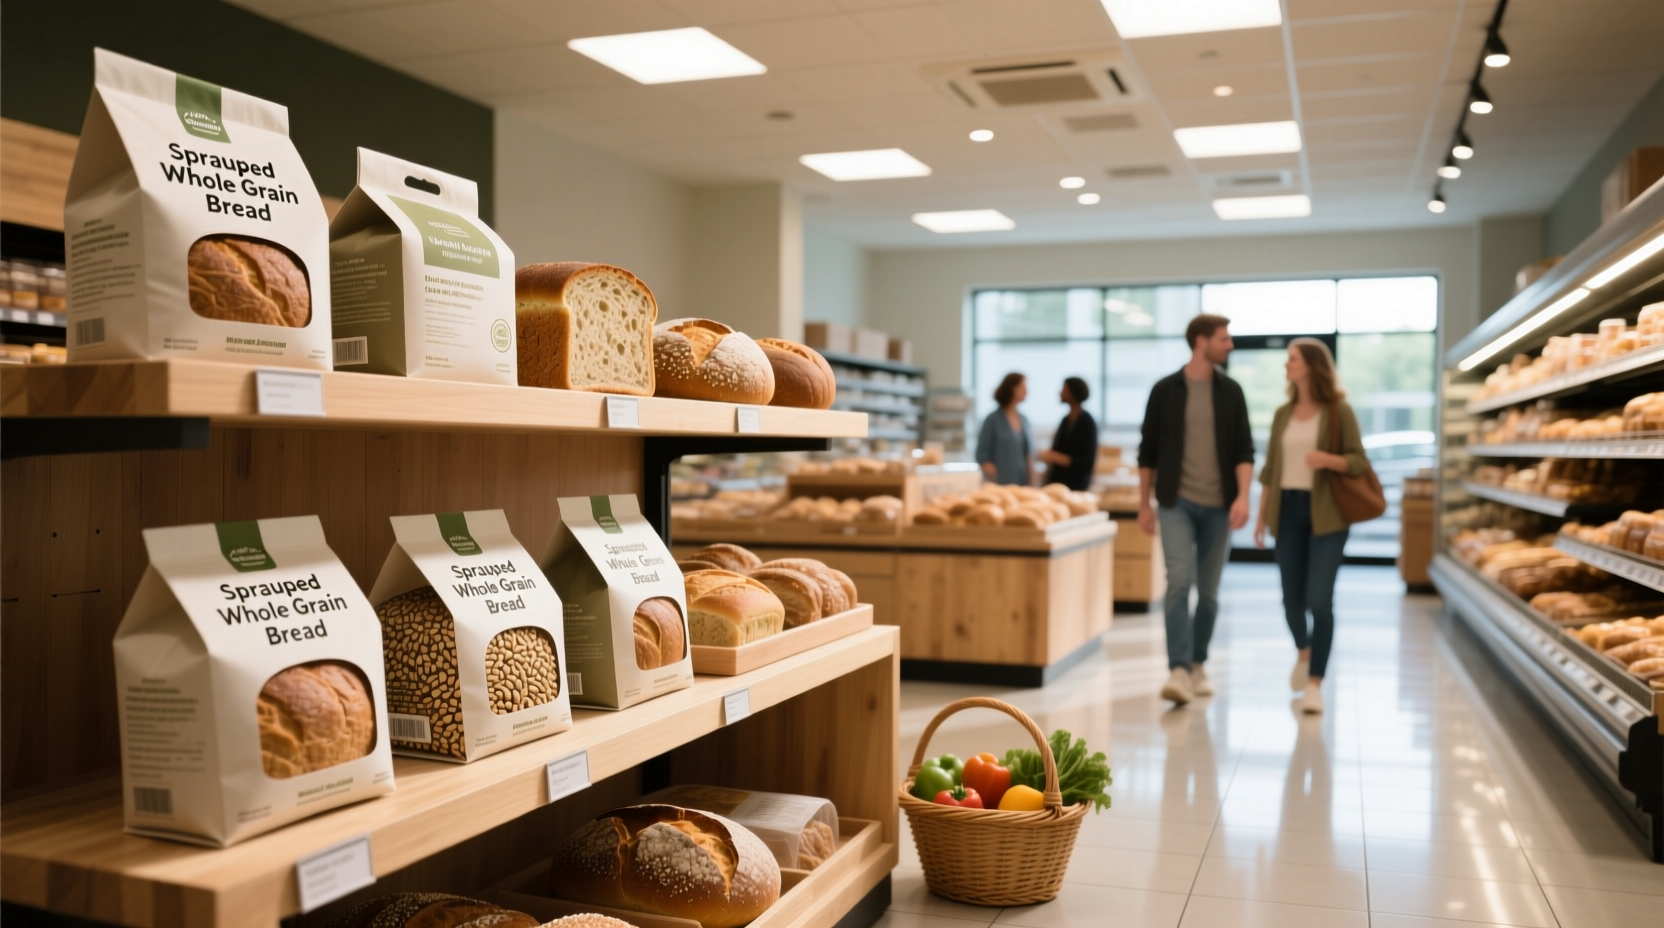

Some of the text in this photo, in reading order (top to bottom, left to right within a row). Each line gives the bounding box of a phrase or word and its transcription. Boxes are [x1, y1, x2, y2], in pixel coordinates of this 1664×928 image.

[168, 143, 276, 178] Sprauped
[159, 161, 299, 205] Whole Grain
[205, 193, 272, 222] Bread
[219, 573, 321, 603] Sprauped
[499, 575, 537, 592] Grain
[216, 593, 348, 626] Whole Grain
[265, 618, 328, 646] Bread
